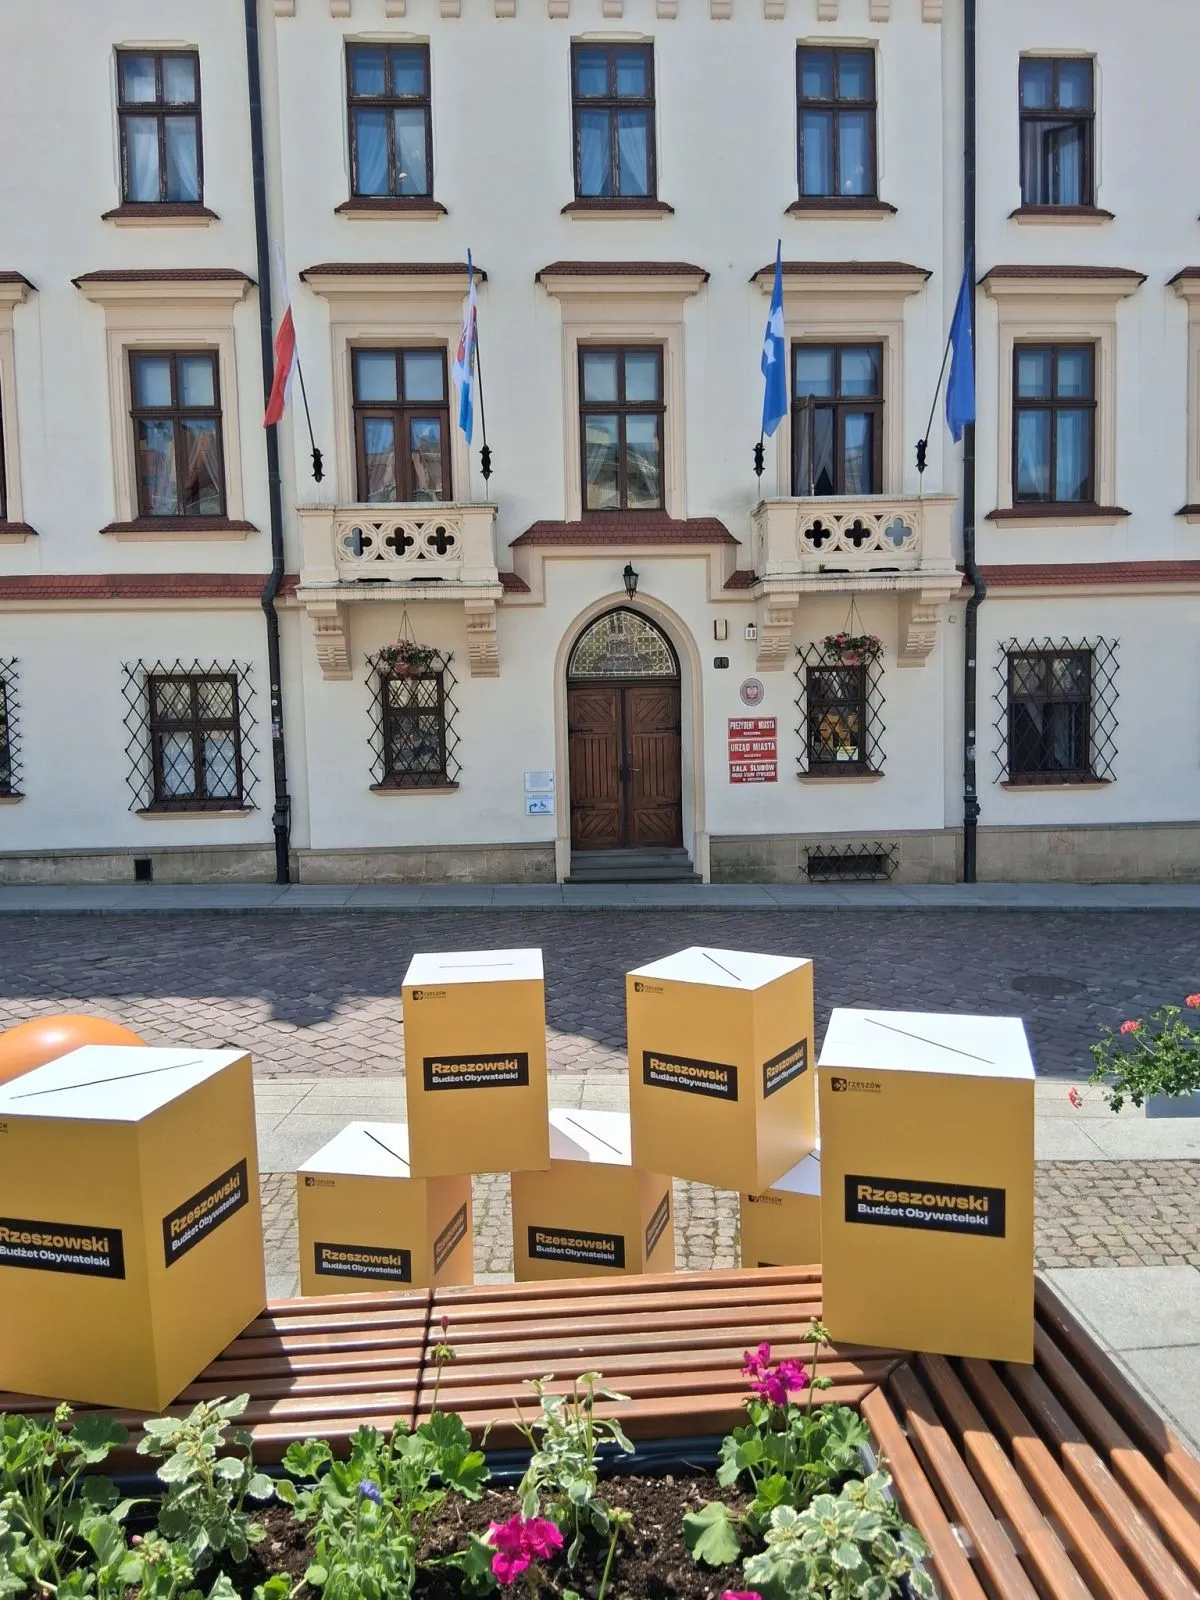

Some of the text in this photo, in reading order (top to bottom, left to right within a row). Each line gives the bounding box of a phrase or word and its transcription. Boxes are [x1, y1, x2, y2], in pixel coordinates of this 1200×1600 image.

[730, 720, 775, 730] PREZYDENT MIASTA
[730, 742, 775, 752] URZĄD MIASTA
[750, 763, 775, 771] ŚLUBÓW
[431, 1059, 518, 1074] Rzeszowski
[650, 1058, 728, 1082] Rzeszowski
[432, 1072, 518, 1083] Budżet Obywatelski
[650, 1071, 728, 1092] Budżet Obywatelski
[170, 1172, 240, 1237] Rzeszowski
[857, 1184, 989, 1212] Rzeszowski
[171, 1189, 241, 1251] Budżet Obywatelski
[857, 1203, 989, 1225] Budżet Obywatelski
[0, 1226, 109, 1253] Rzeszowski
[535, 1232, 615, 1251] Rzeszowski
[0, 1245, 110, 1266] Budżet Obywatelski
[322, 1248, 401, 1266] Rzeszowski
[536, 1244, 615, 1260] Budżet Obywatelski
[322, 1260, 402, 1275] Budżet Obywatelski
